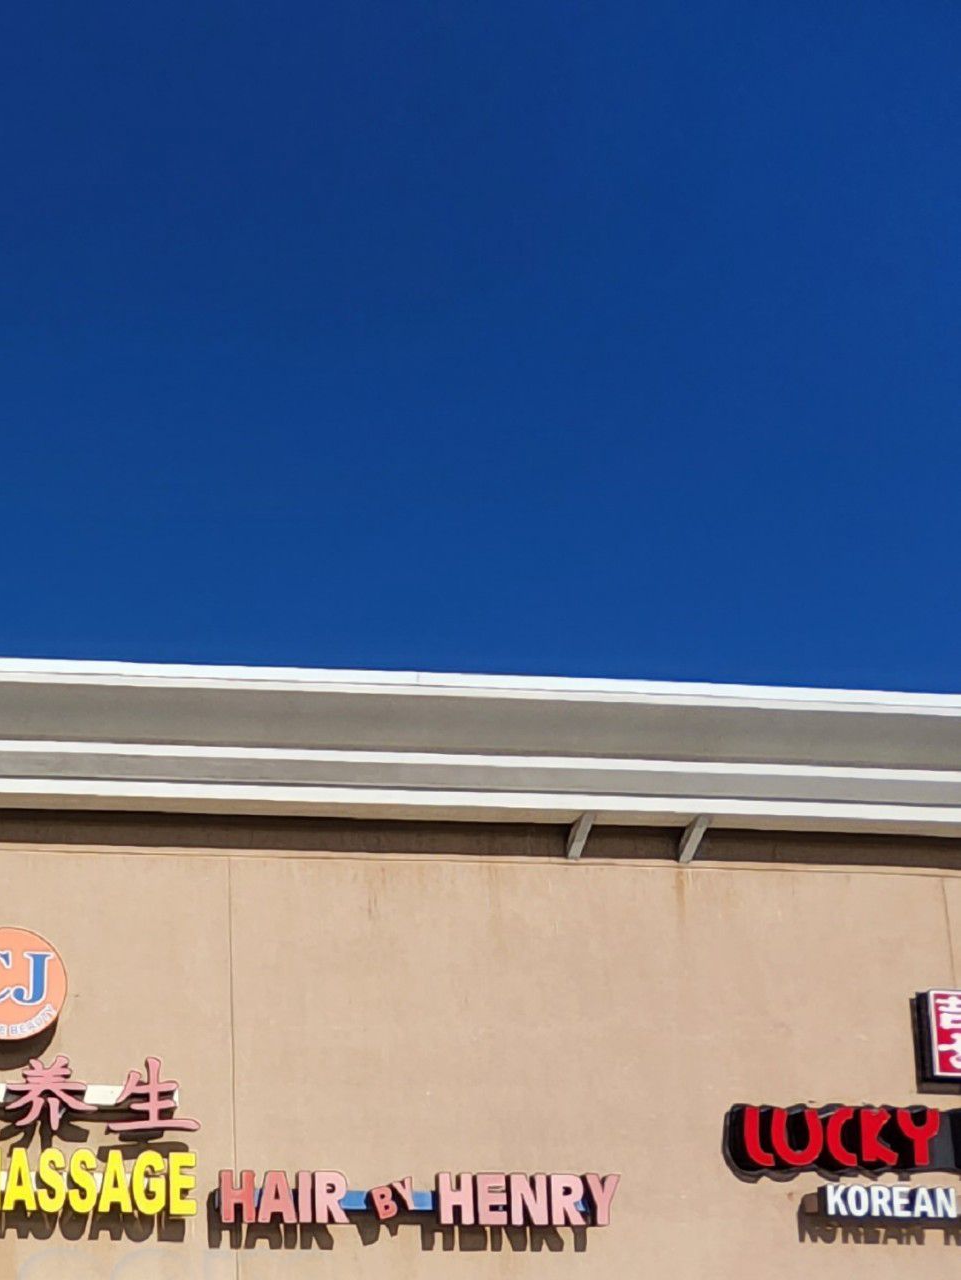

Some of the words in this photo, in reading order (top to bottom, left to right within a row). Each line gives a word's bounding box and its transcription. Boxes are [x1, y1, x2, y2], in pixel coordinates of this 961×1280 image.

[743, 1106, 940, 1167] LUCKY
[219, 1170, 350, 1223] HAIR
[370, 1177, 417, 1220] BY
[437, 1172, 621, 1226] HENRY
[826, 1183, 958, 1218] KOREAN
